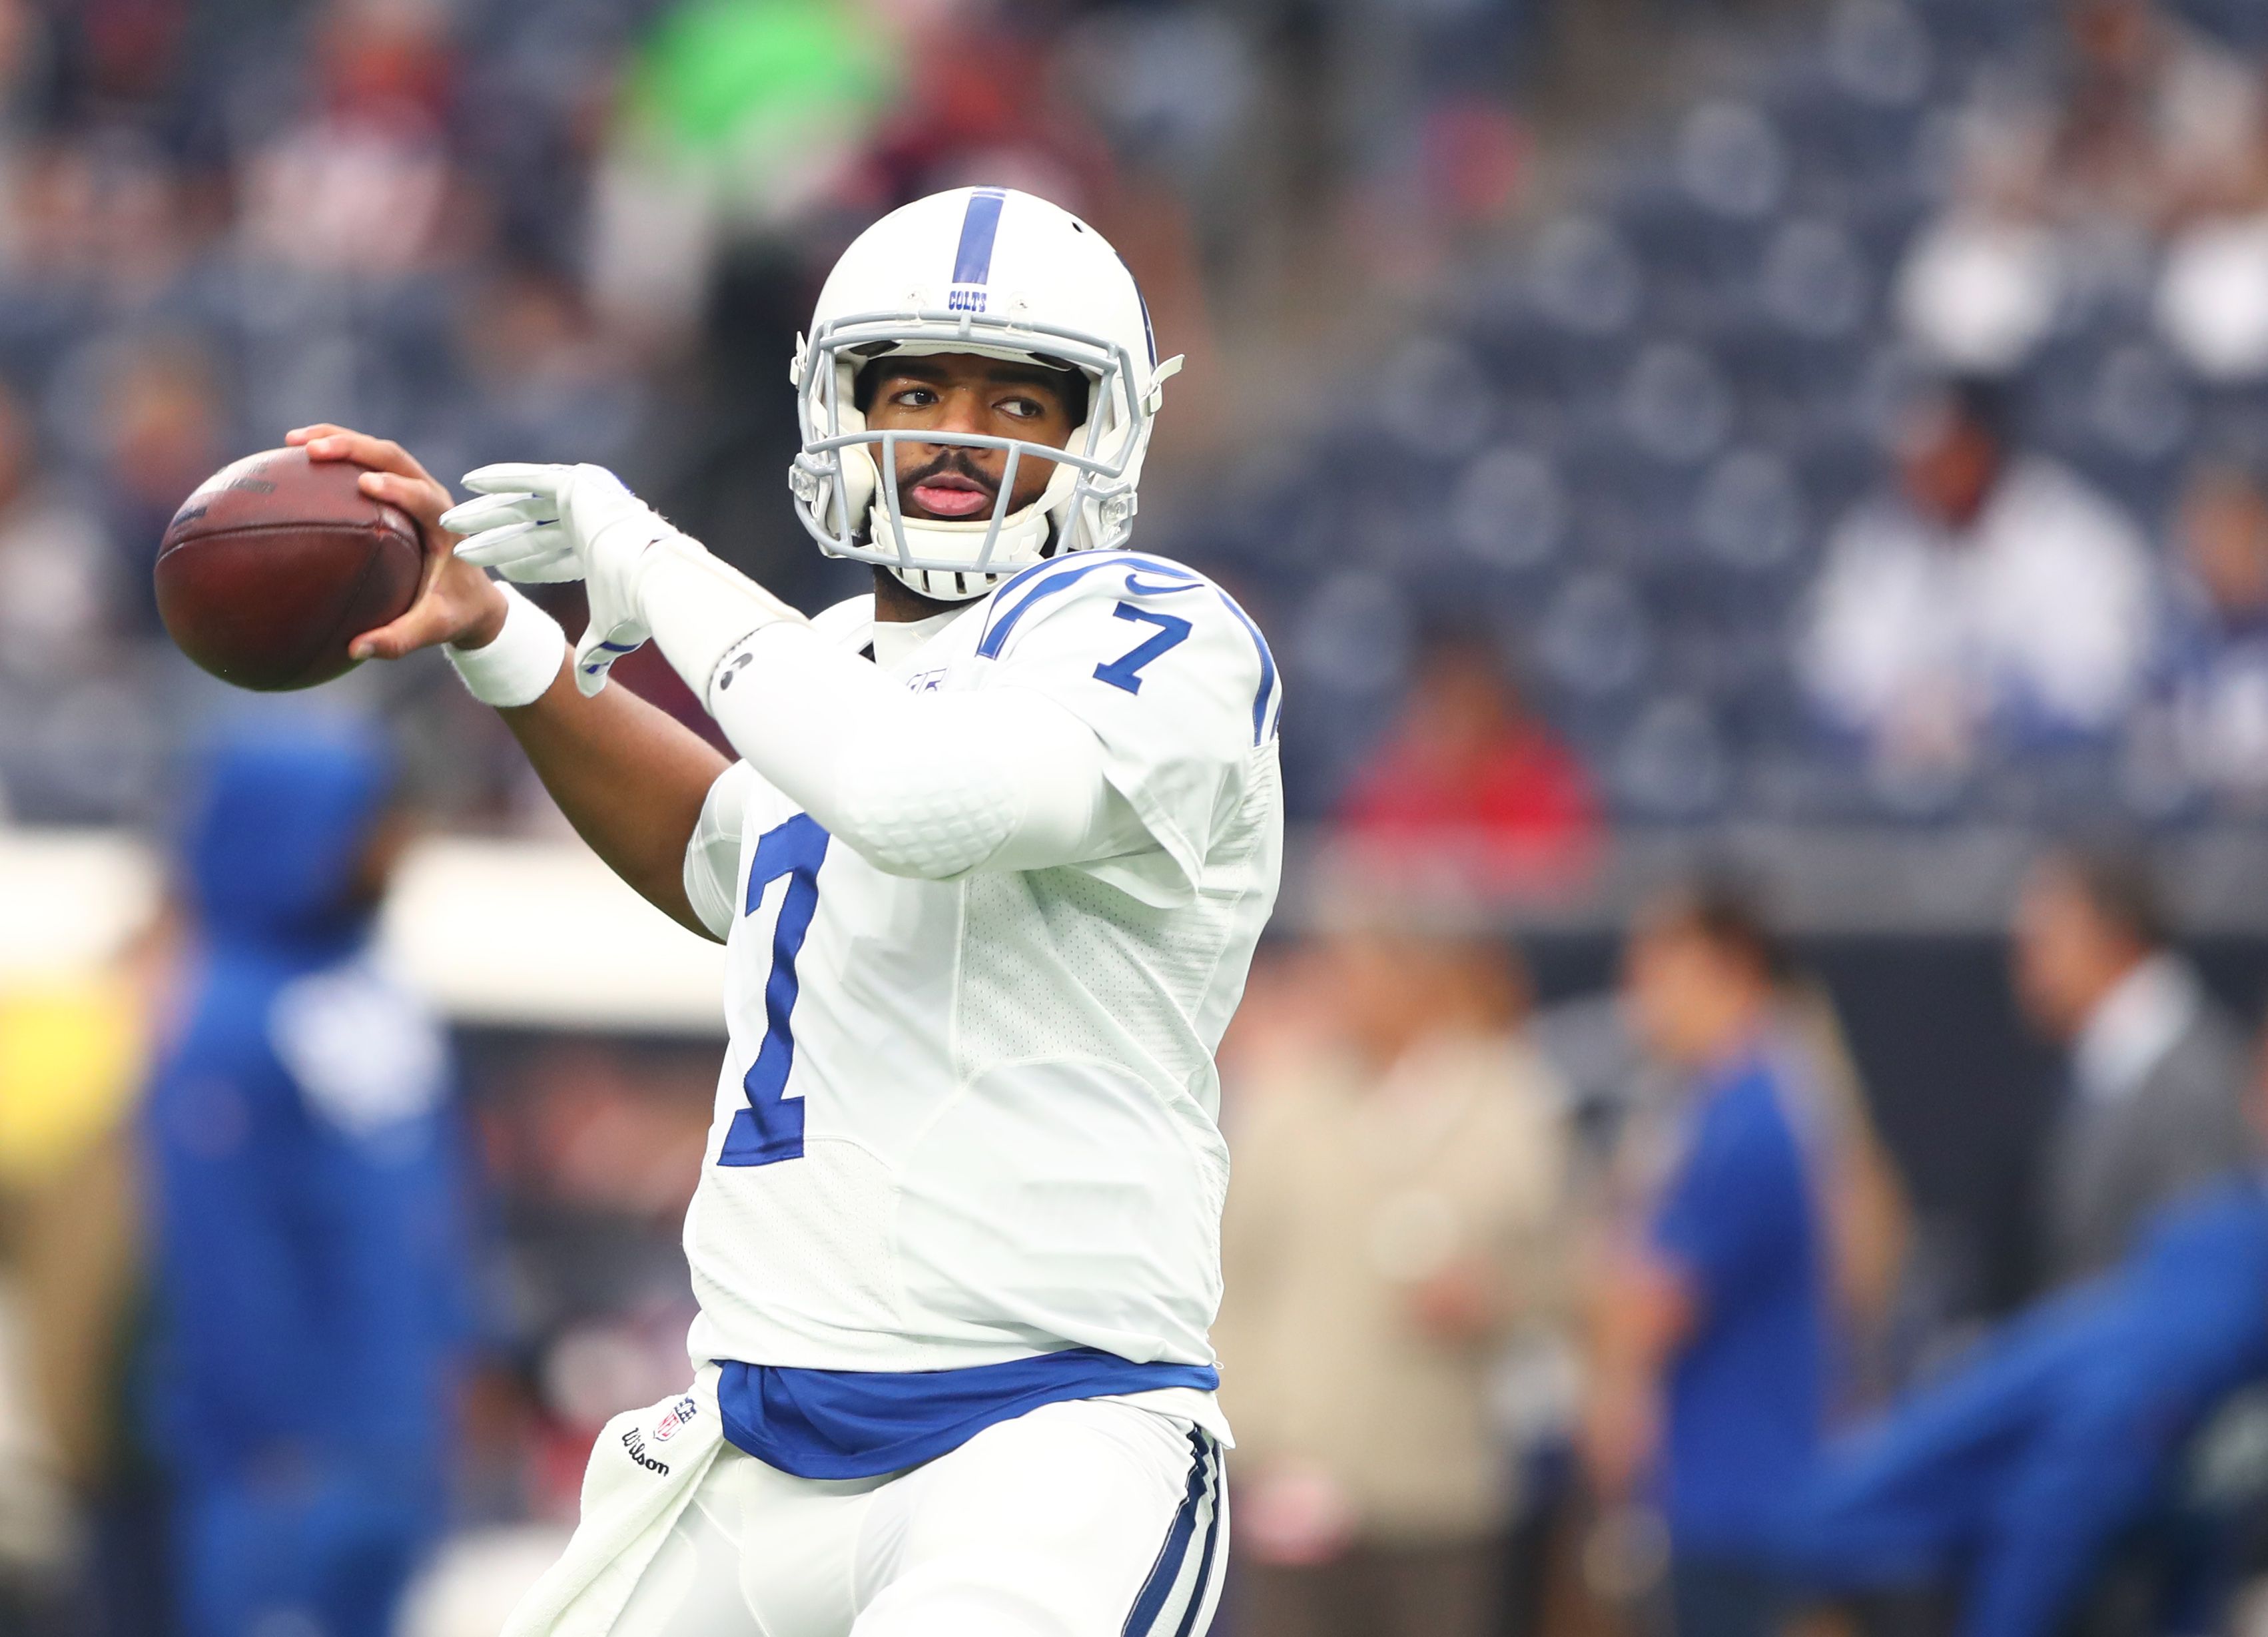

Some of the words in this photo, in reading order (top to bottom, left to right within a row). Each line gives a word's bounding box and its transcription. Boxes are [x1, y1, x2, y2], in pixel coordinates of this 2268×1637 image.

[948, 290, 987, 312] COLTS
[1093, 601, 1192, 695] 7
[717, 811, 831, 1167] 7
[621, 1427, 669, 1477] Wilson
